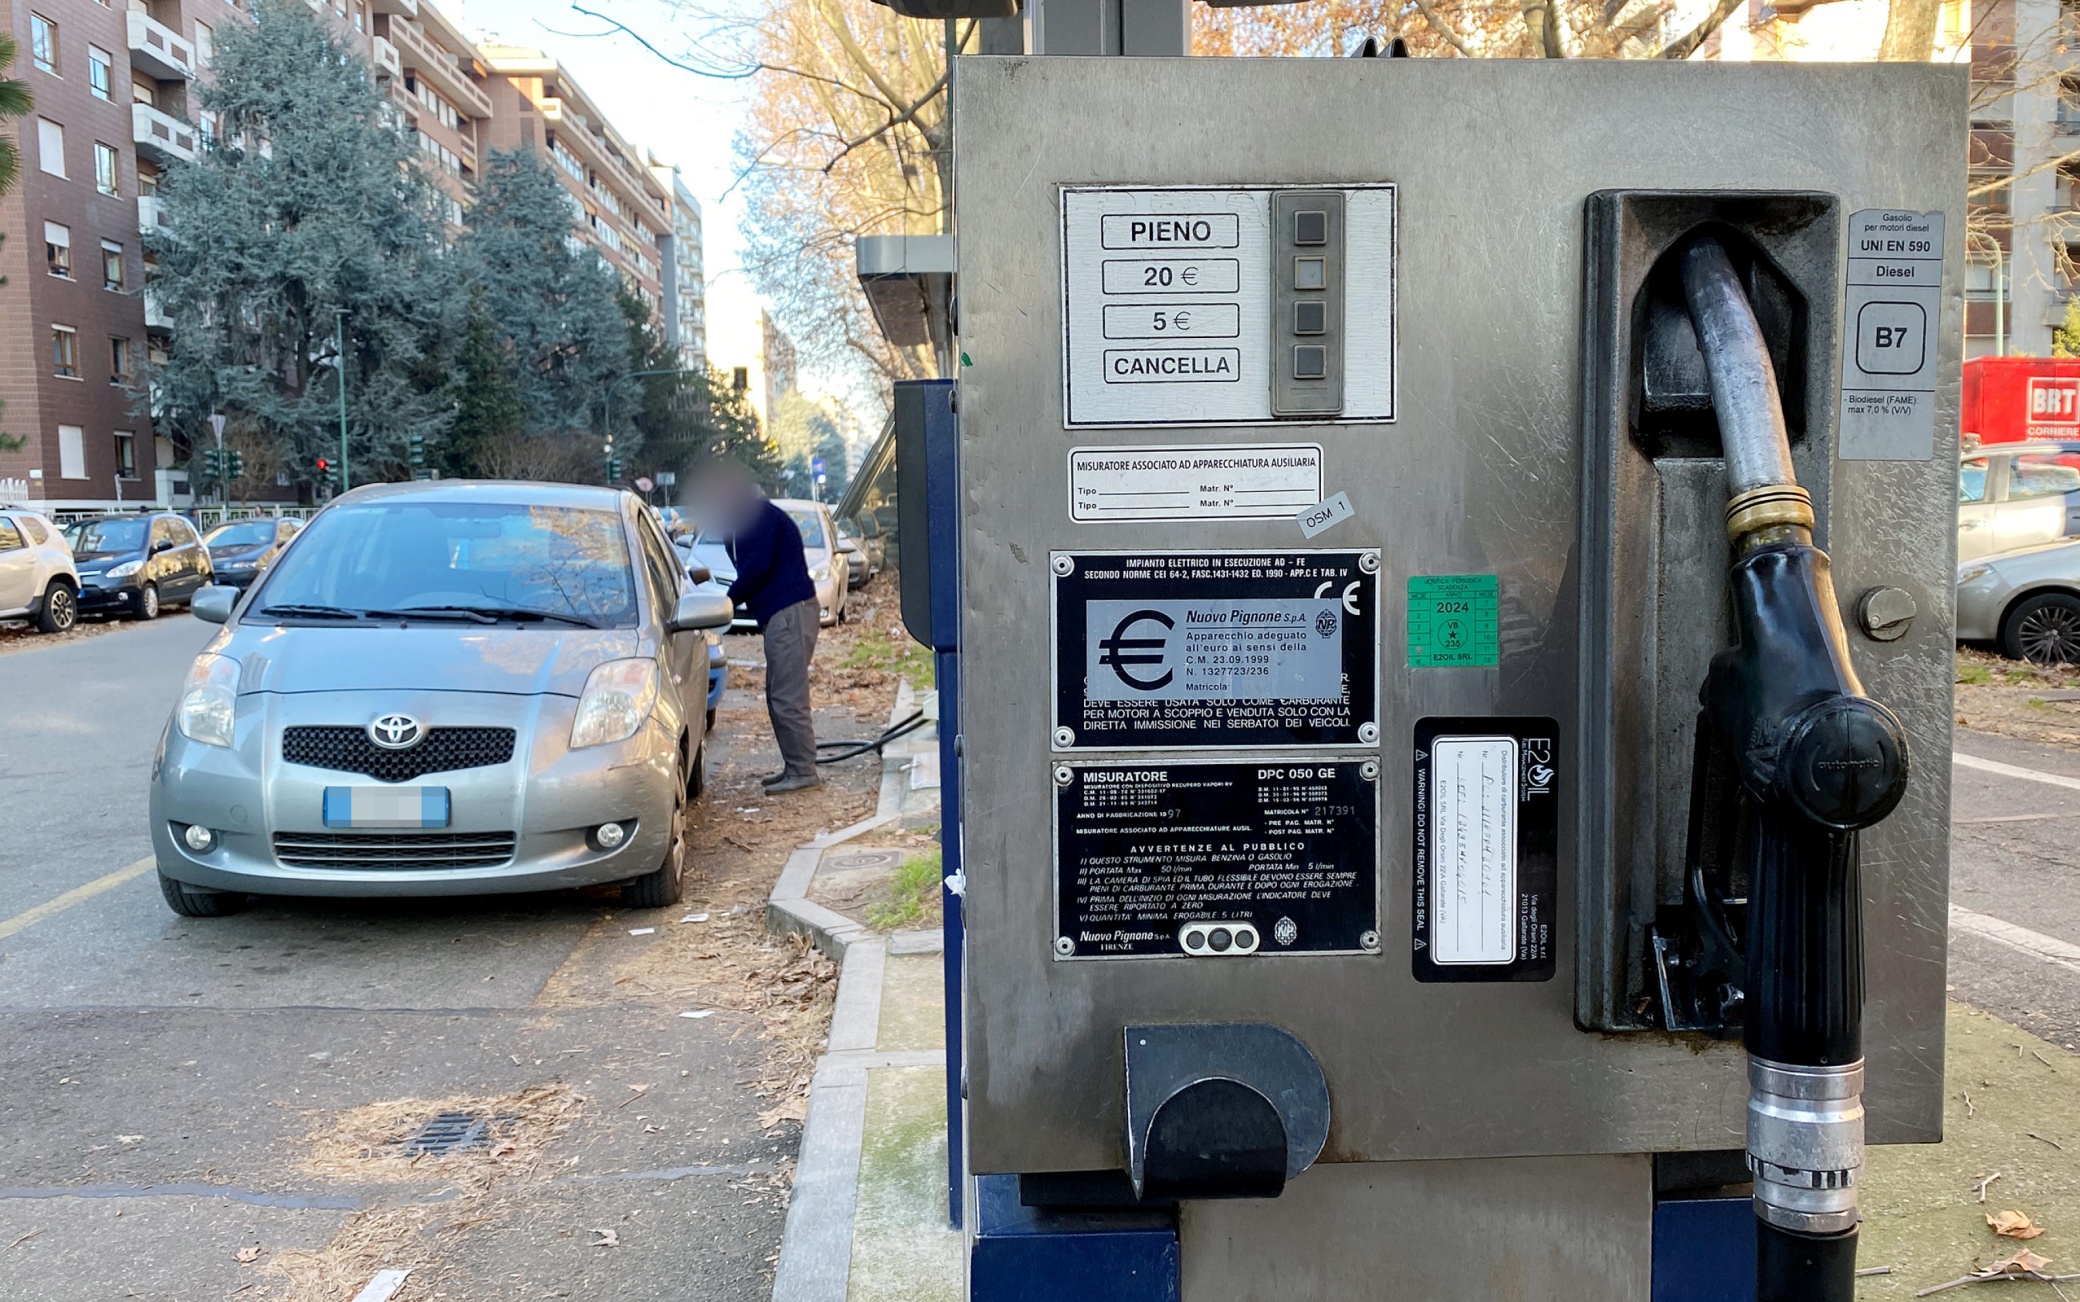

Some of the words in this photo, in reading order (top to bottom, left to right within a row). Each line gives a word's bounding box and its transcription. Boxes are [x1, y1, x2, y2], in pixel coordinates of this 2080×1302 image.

[1882, 213, 1912, 223] Gasolio
[1131, 220, 1212, 242] PIENO
[1864, 224, 1878, 233] per
[1879, 223, 1904, 232] motori
[1906, 223, 1930, 232] diesel
[1861, 240, 1883, 251] UNI
[1886, 240, 1905, 251] EN
[1908, 241, 1931, 252] 590
[1143, 266, 1173, 286] 20
[1180, 266, 1199, 286] €
[1876, 265, 1915, 278] Diesel
[1152, 311, 1167, 331] 5
[1172, 311, 1191, 331] €
[1875, 327, 1908, 348] B7
[1114, 356, 1230, 375] CANCELLA
[1848, 395, 1885, 404] Biodiesel
[2033, 388, 2076, 414] BRT
[1848, 406, 1864, 414] max
[1882, 406, 1889, 414] %
[2027, 427, 2080, 436] CORRIERE
[1077, 460, 1130, 472] MISURATORE
[1131, 459, 1177, 471] ASSOCIATO
[1179, 459, 1191, 470] AD
[1193, 458, 1269, 470] APPARECCHIATURA
[1271, 457, 1316, 468] AUSILIARIA
[1078, 487, 1097, 496] Tipo
[1200, 484, 1221, 493] Matr.
[1078, 502, 1097, 511] Tipo
[1200, 499, 1221, 508] Matr.
[1305, 507, 1334, 529] OSM
[1338, 501, 1346, 511] 1
[1126, 558, 1165, 568] IMPIANTO
[1168, 558, 1209, 567] ELETTRICO
[1212, 558, 1222, 567] IN
[1224, 558, 1271, 567] ESECUZIONE
[1296, 557, 1306, 566] FE
[1084, 570, 1120, 579] SECONDO
[1122, 570, 1151, 579] NORME
[1154, 569, 1167, 579] CEI
[1265, 569, 1283, 578] 1990
[1320, 568, 1337, 577] TAB.
[1339, 568, 1348, 577] IV
[1436, 602, 1469, 614] 2024
[1186, 610, 1227, 623] Nuovo
[1230, 609, 1282, 626] Pignone
[1447, 621, 1459, 629] VB
[1186, 631, 1254, 642] Apparecchio
[1257, 631, 1307, 642] adeguato
[1232, 643, 1242, 652] ai
[1246, 643, 1276, 652] sensi
[1280, 642, 1307, 651] della
[1186, 655, 1209, 664] C.M.
[1213, 655, 1269, 664] 23.09.1999
[1186, 667, 1197, 676] N.
[1202, 667, 1269, 676] 1327723/236
[1083, 699, 1111, 708] DEVE
[1117, 699, 1158, 707] ESSERE
[1164, 699, 1200, 707] USATA
[1206, 699, 1237, 707] SOLO
[1242, 698, 1276, 706] COME
[1083, 709, 1105, 719] PER
[1107, 709, 1150, 719] MOTORI
[1152, 708, 1161, 718] A
[1164, 708, 1213, 718] SCOPPIO
[1216, 708, 1223, 717] E
[1226, 707, 1275, 717] VENDUTA
[1277, 707, 1307, 717] SOLO
[1310, 706, 1335, 716] CON
[1337, 706, 1351, 716] LA
[1083, 720, 1127, 730] DIRETTA
[1134, 719, 1197, 730] IMMISSIONE
[1203, 719, 1221, 729] NEI
[1226, 719, 1279, 728] SERBATOI
[1285, 718, 1302, 728] DEI
[1817, 757, 1880, 771] automatic
[1083, 771, 1168, 783] MISURATORE
[1257, 769, 1285, 780] DPC
[1288, 768, 1314, 779] 050
[1317, 768, 1336, 779] GE
[1417, 768, 1426, 812] WARNING!
[1314, 805, 1355, 816] 217391
[1417, 813, 1426, 828] DO
[1417, 828, 1426, 846] NOT
[1130, 844, 1213, 853] AVVERTENZE
[1220, 843, 1235, 852] AL
[1243, 842, 1305, 851] PUBBLICO
[1089, 857, 1121, 865] QUESTO
[1123, 855, 1173, 864] STRUMENTO
[1175, 855, 1207, 863] MISURA
[1211, 854, 1246, 862] BENZINA
[1257, 853, 1292, 861] GASOLIO
[1089, 867, 1124, 875] PORTATA
[1248, 863, 1283, 871] PORTATA
[1416, 848, 1425, 886] REMOVE
[1089, 877, 1101, 885] LA
[1104, 876, 1139, 884] CAMERA
[1141, 876, 1151, 884] DI
[1152, 875, 1171, 883] SPIA
[1217, 874, 1259, 882] FLESSIBILE
[1260, 873, 1294, 881] DEVONO
[1295, 872, 1324, 880] ESSERE
[1326, 871, 1357, 879] SEMPRE
[1089, 885, 1109, 893] PIENI
[1112, 885, 1121, 893] DI
[1122, 884, 1176, 892] CARBURANTE
[1207, 882, 1245, 891] DURANTE
[1254, 881, 1278, 890] DOPO
[1280, 881, 1300, 889] OGNI
[1089, 895, 1115, 903] PRIMA
[1165, 894, 1175, 902] DI
[1176, 893, 1197, 902] OGNI
[1198, 892, 1252, 901] MISURAZIONE
[1311, 890, 1332, 899] DEVE
[1416, 887, 1425, 907] THIS
[1530, 894, 1538, 906] Via
[1123, 902, 1167, 911] RIPORTATO
[1171, 902, 1177, 910] A
[1181, 901, 1204, 910] ZERO
[1231, 910, 1254, 919] LITRI
[1416, 908, 1425, 931] SEAL
[1080, 931, 1112, 942] Nuovo
[1113, 930, 1154, 942] Pignone
[1100, 943, 1134, 951] FIRENZE
